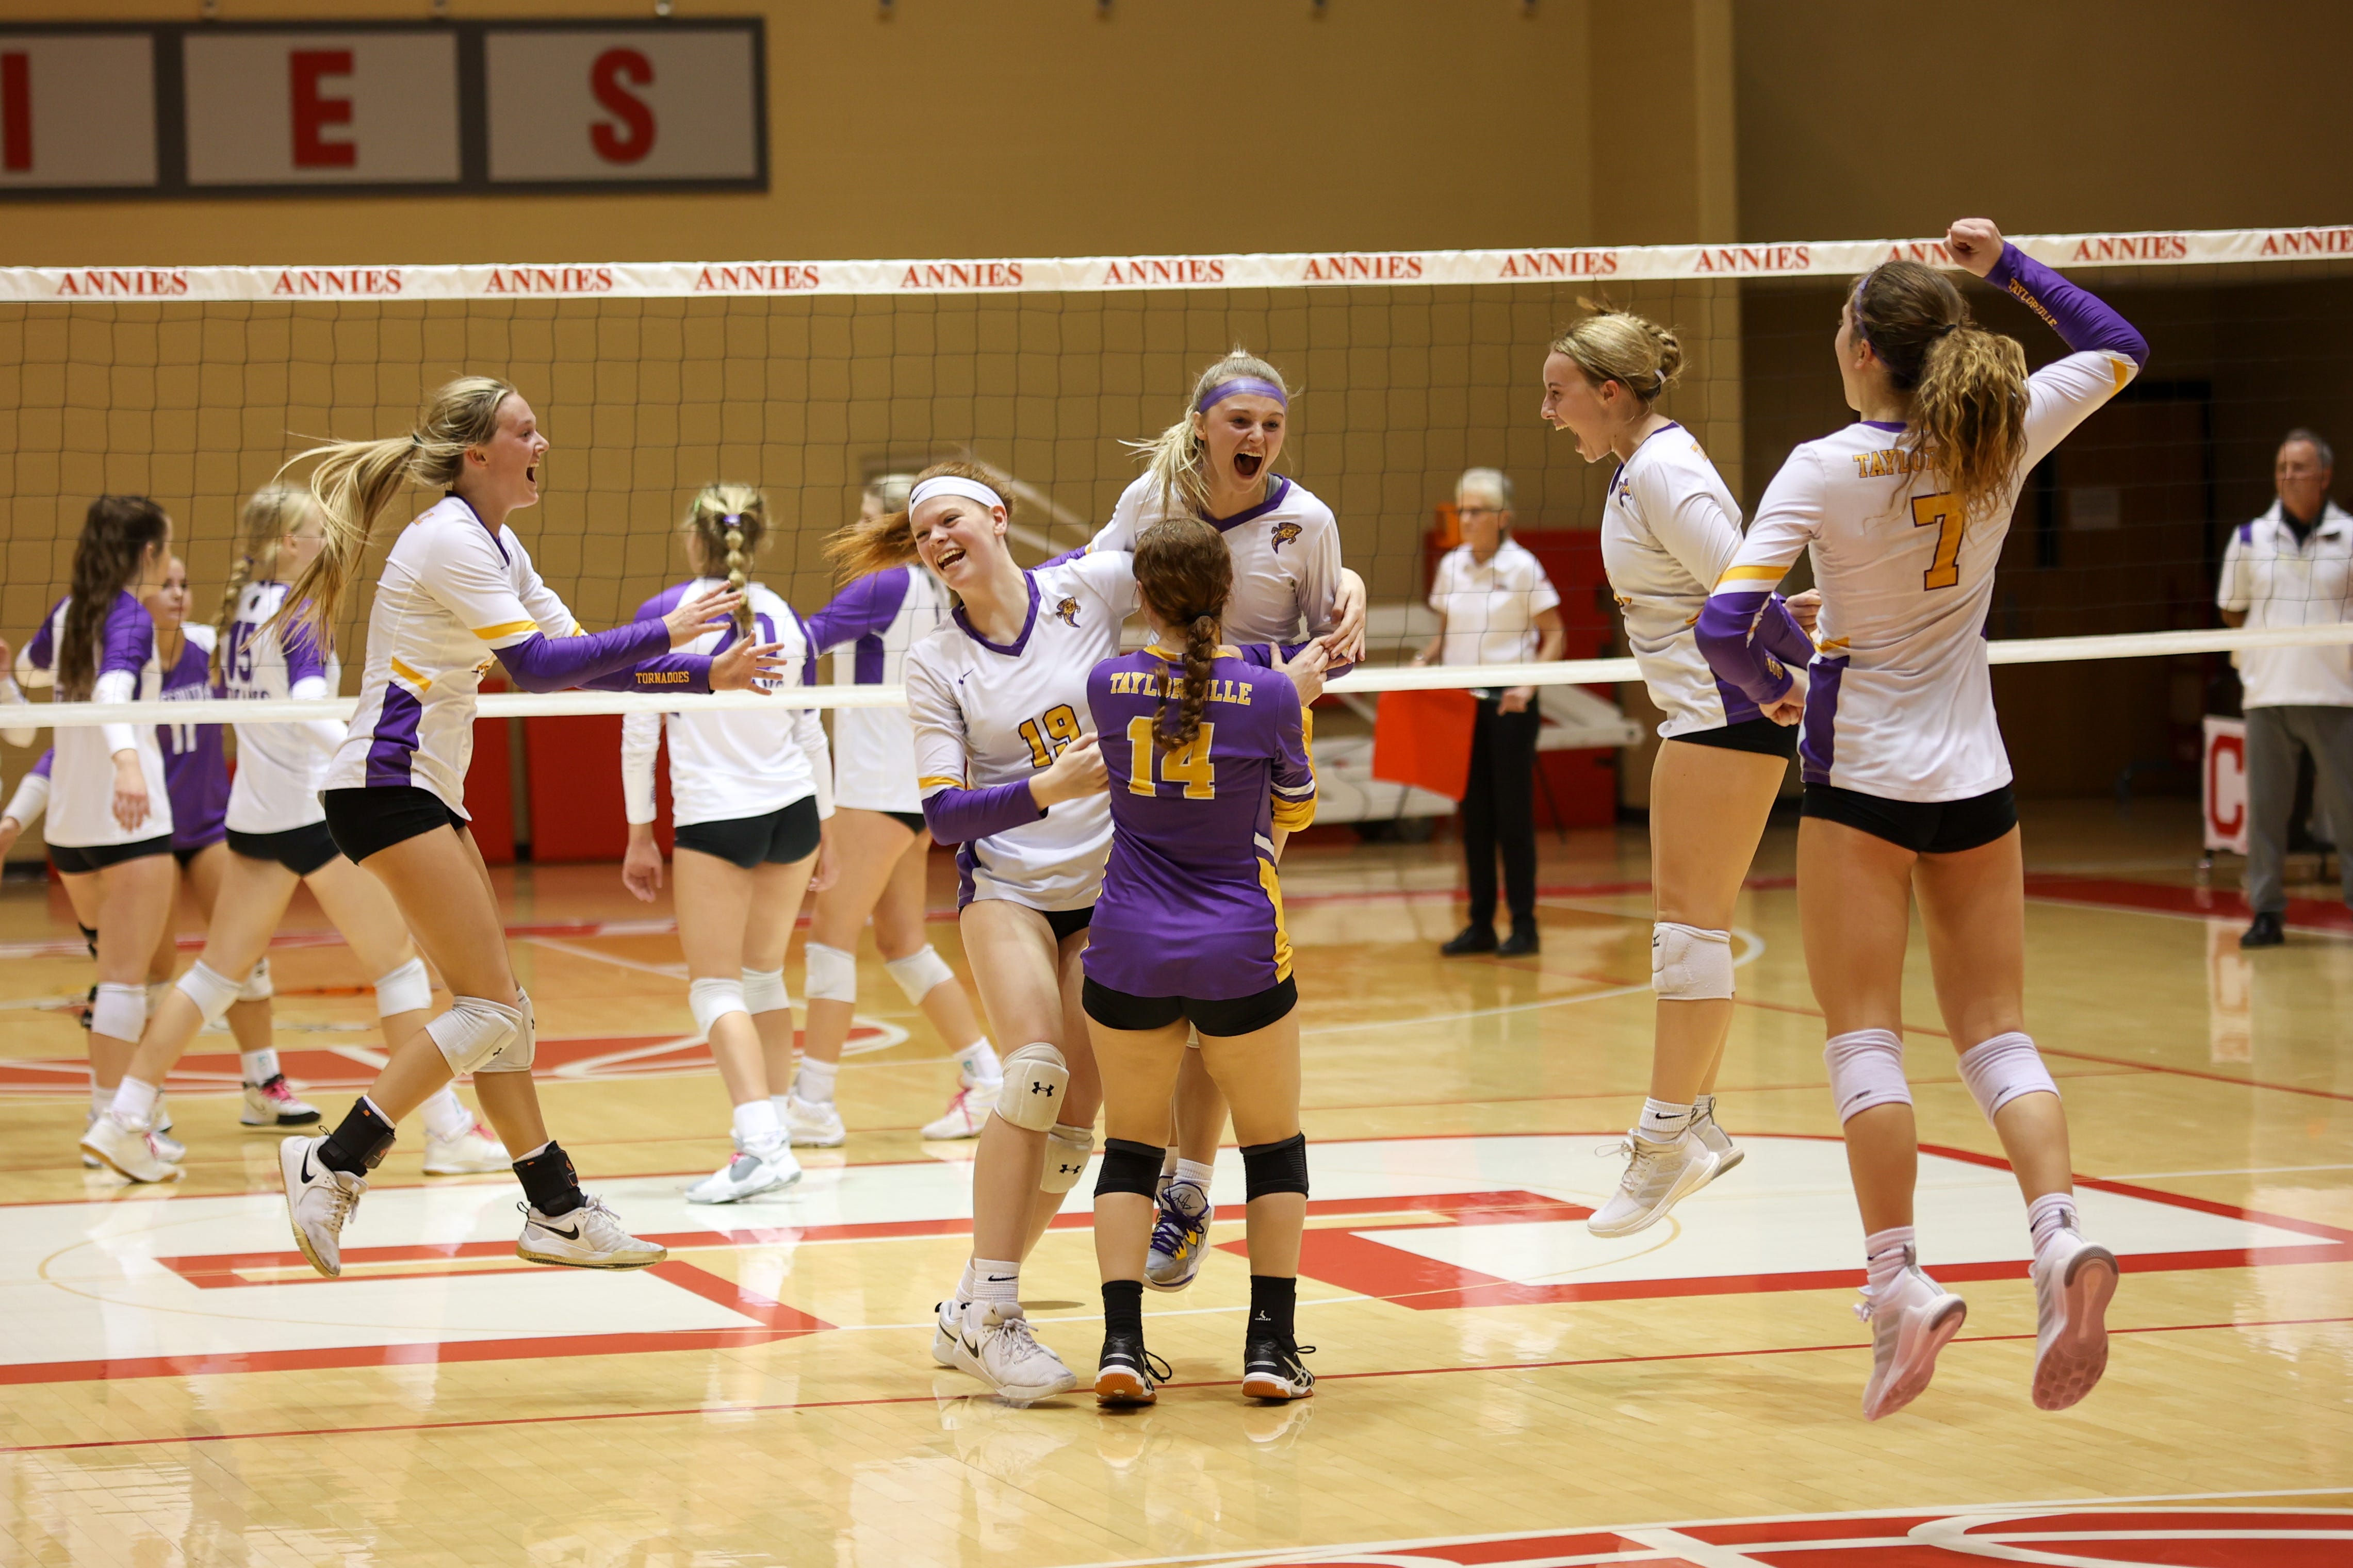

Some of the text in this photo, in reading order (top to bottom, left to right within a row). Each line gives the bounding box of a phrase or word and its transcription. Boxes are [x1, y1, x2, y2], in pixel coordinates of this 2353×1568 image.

[56, 230, 2353, 296] ANNIES ANNIES ANNIES ANNIES ANNIES ANNIES ANNIES ANNIES ANNIES ANN ANNIES ANNIE
[1911, 491, 1964, 591] 7
[635, 671, 690, 685] TORNADOES
[1018, 703, 1082, 769] 19
[1126, 716, 1216, 800] 14
